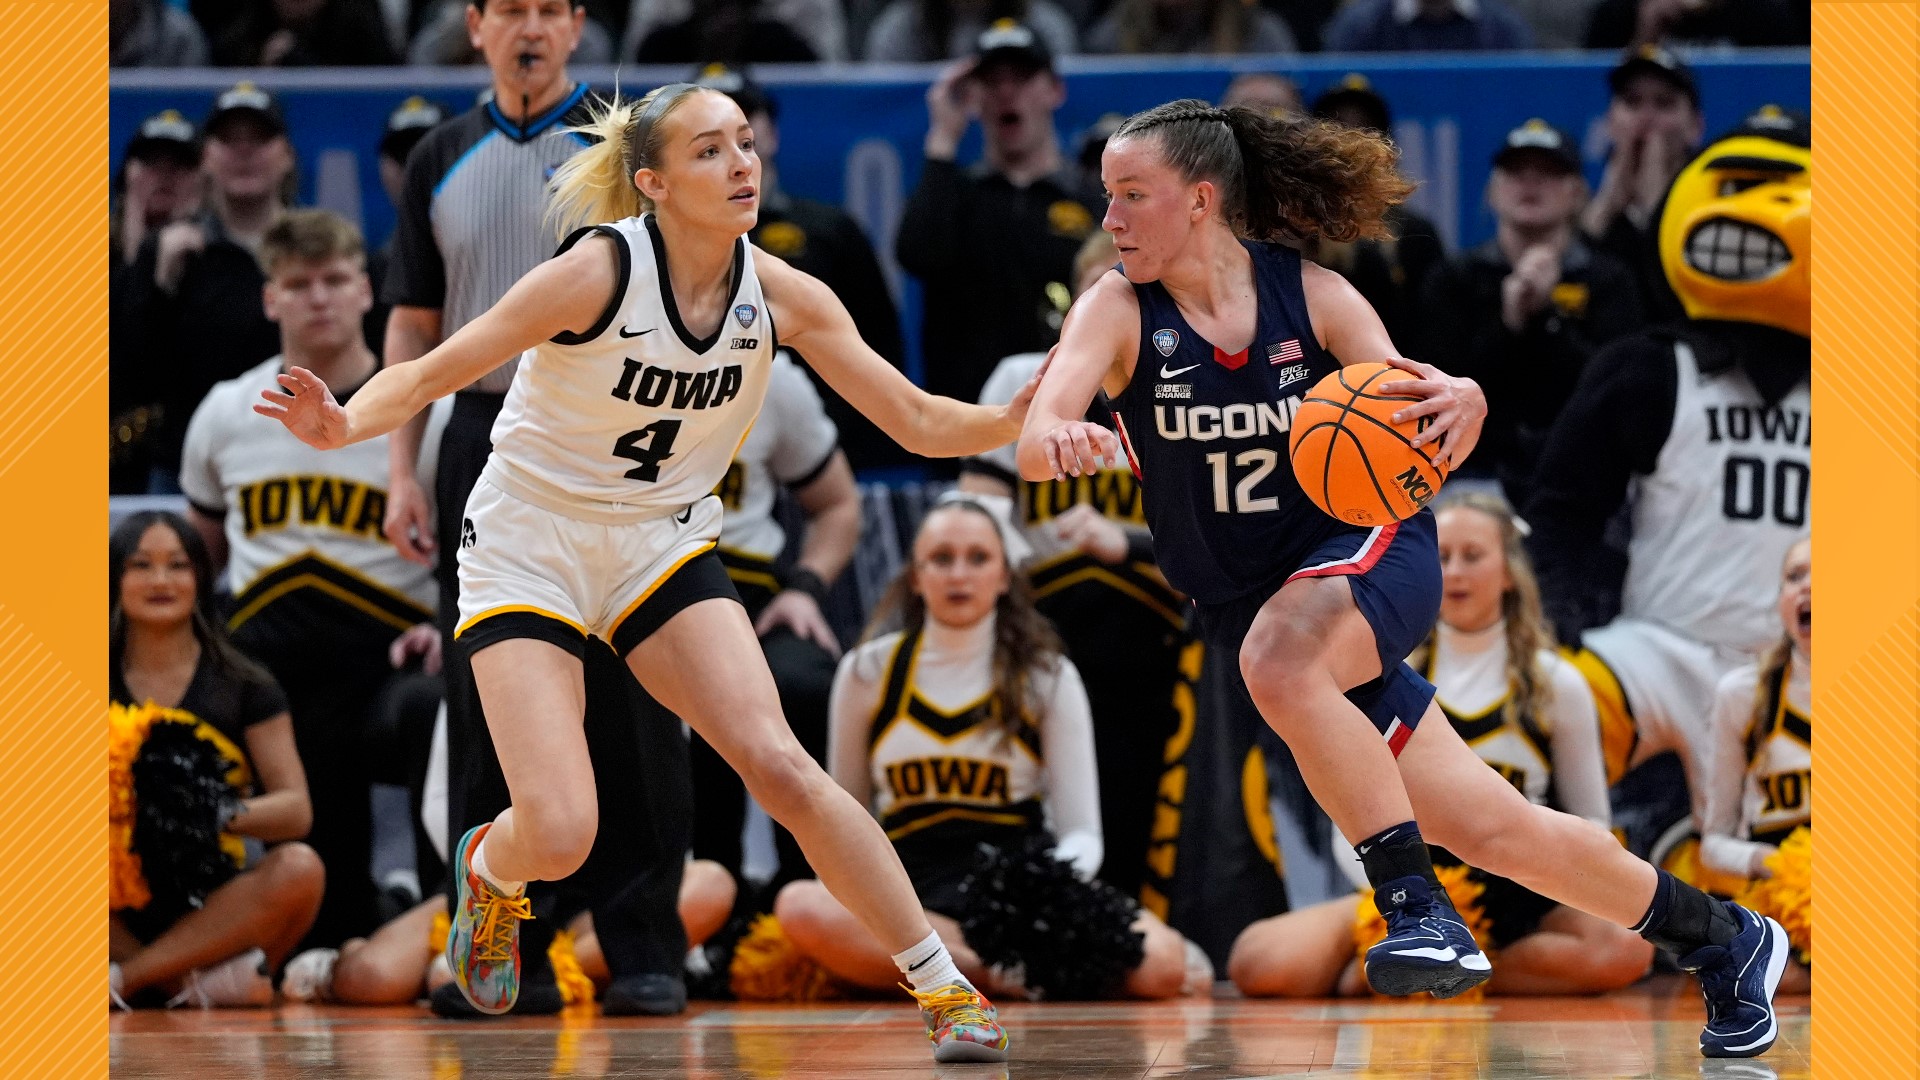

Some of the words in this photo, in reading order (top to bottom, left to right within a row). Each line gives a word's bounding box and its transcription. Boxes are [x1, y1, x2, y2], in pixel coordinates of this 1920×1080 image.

[611, 357, 742, 410] IOWA
[1279, 369, 1310, 385] EAST
[1280, 364, 1303, 377] BIG
[612, 419, 682, 482] 4
[1705, 405, 1811, 447] IOW
[1205, 448, 1279, 514] 12
[1395, 464, 1435, 511] NCA
[1722, 456, 1810, 527] 00
[239, 475, 391, 542] IOWA
[885, 756, 1012, 803] IOWA
